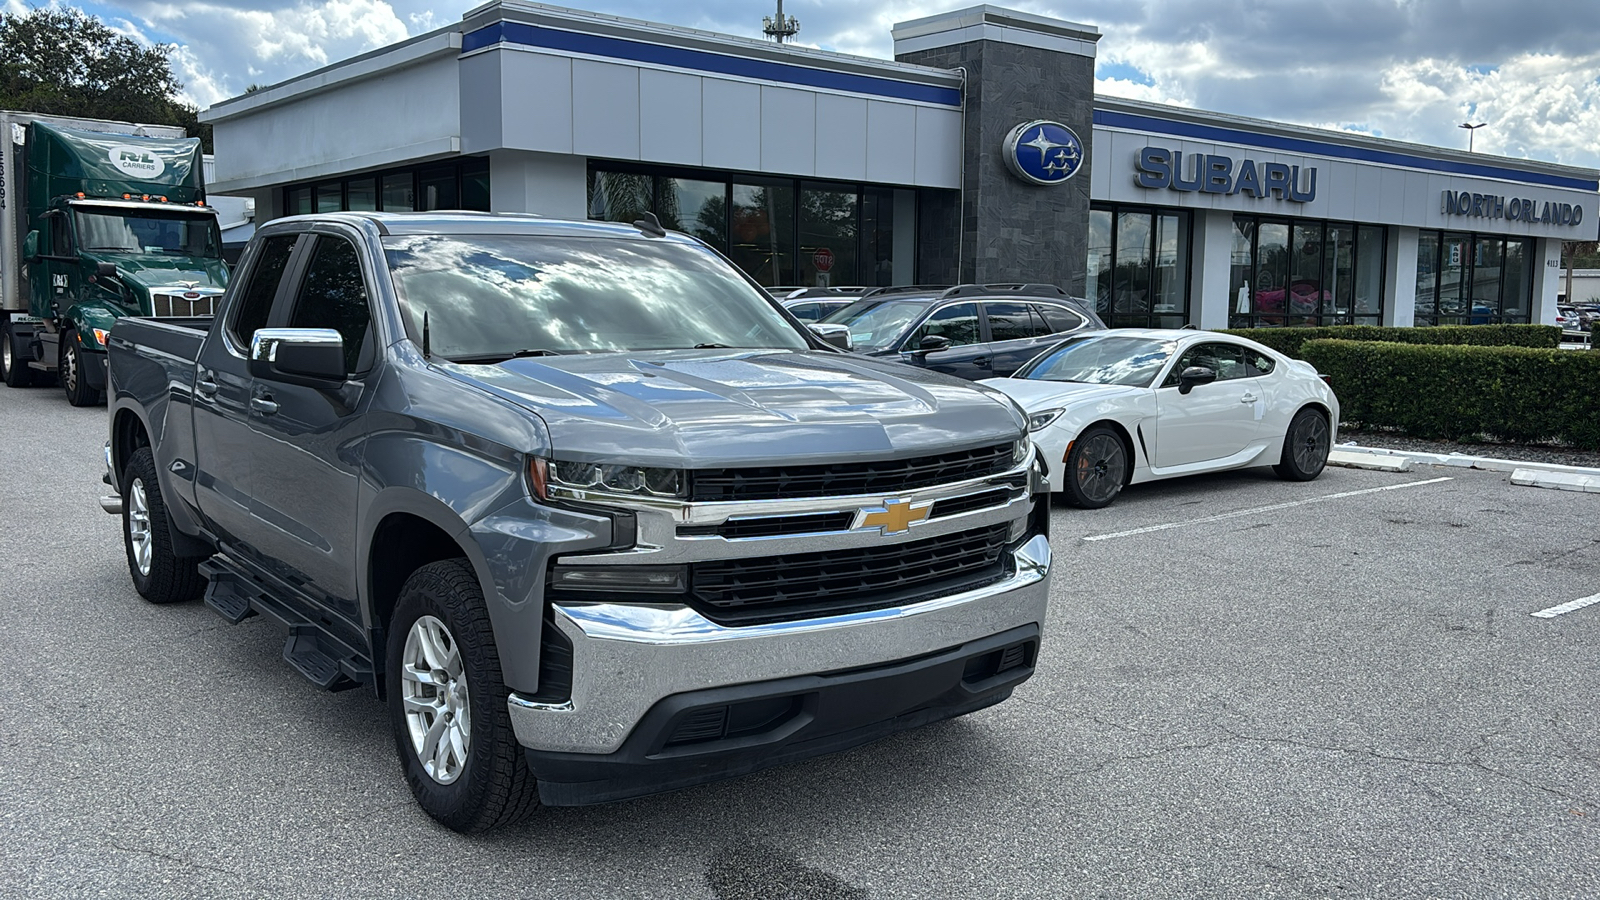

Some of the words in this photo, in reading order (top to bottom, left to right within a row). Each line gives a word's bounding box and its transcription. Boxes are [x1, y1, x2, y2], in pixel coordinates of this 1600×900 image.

[122, 162, 156, 170] CARRIERS
[1134, 147, 1317, 202] SUBARU
[1441, 190, 1505, 218] NORTH
[1505, 197, 1583, 226] ORLANDO
[1546, 259, 1559, 268] 4113
